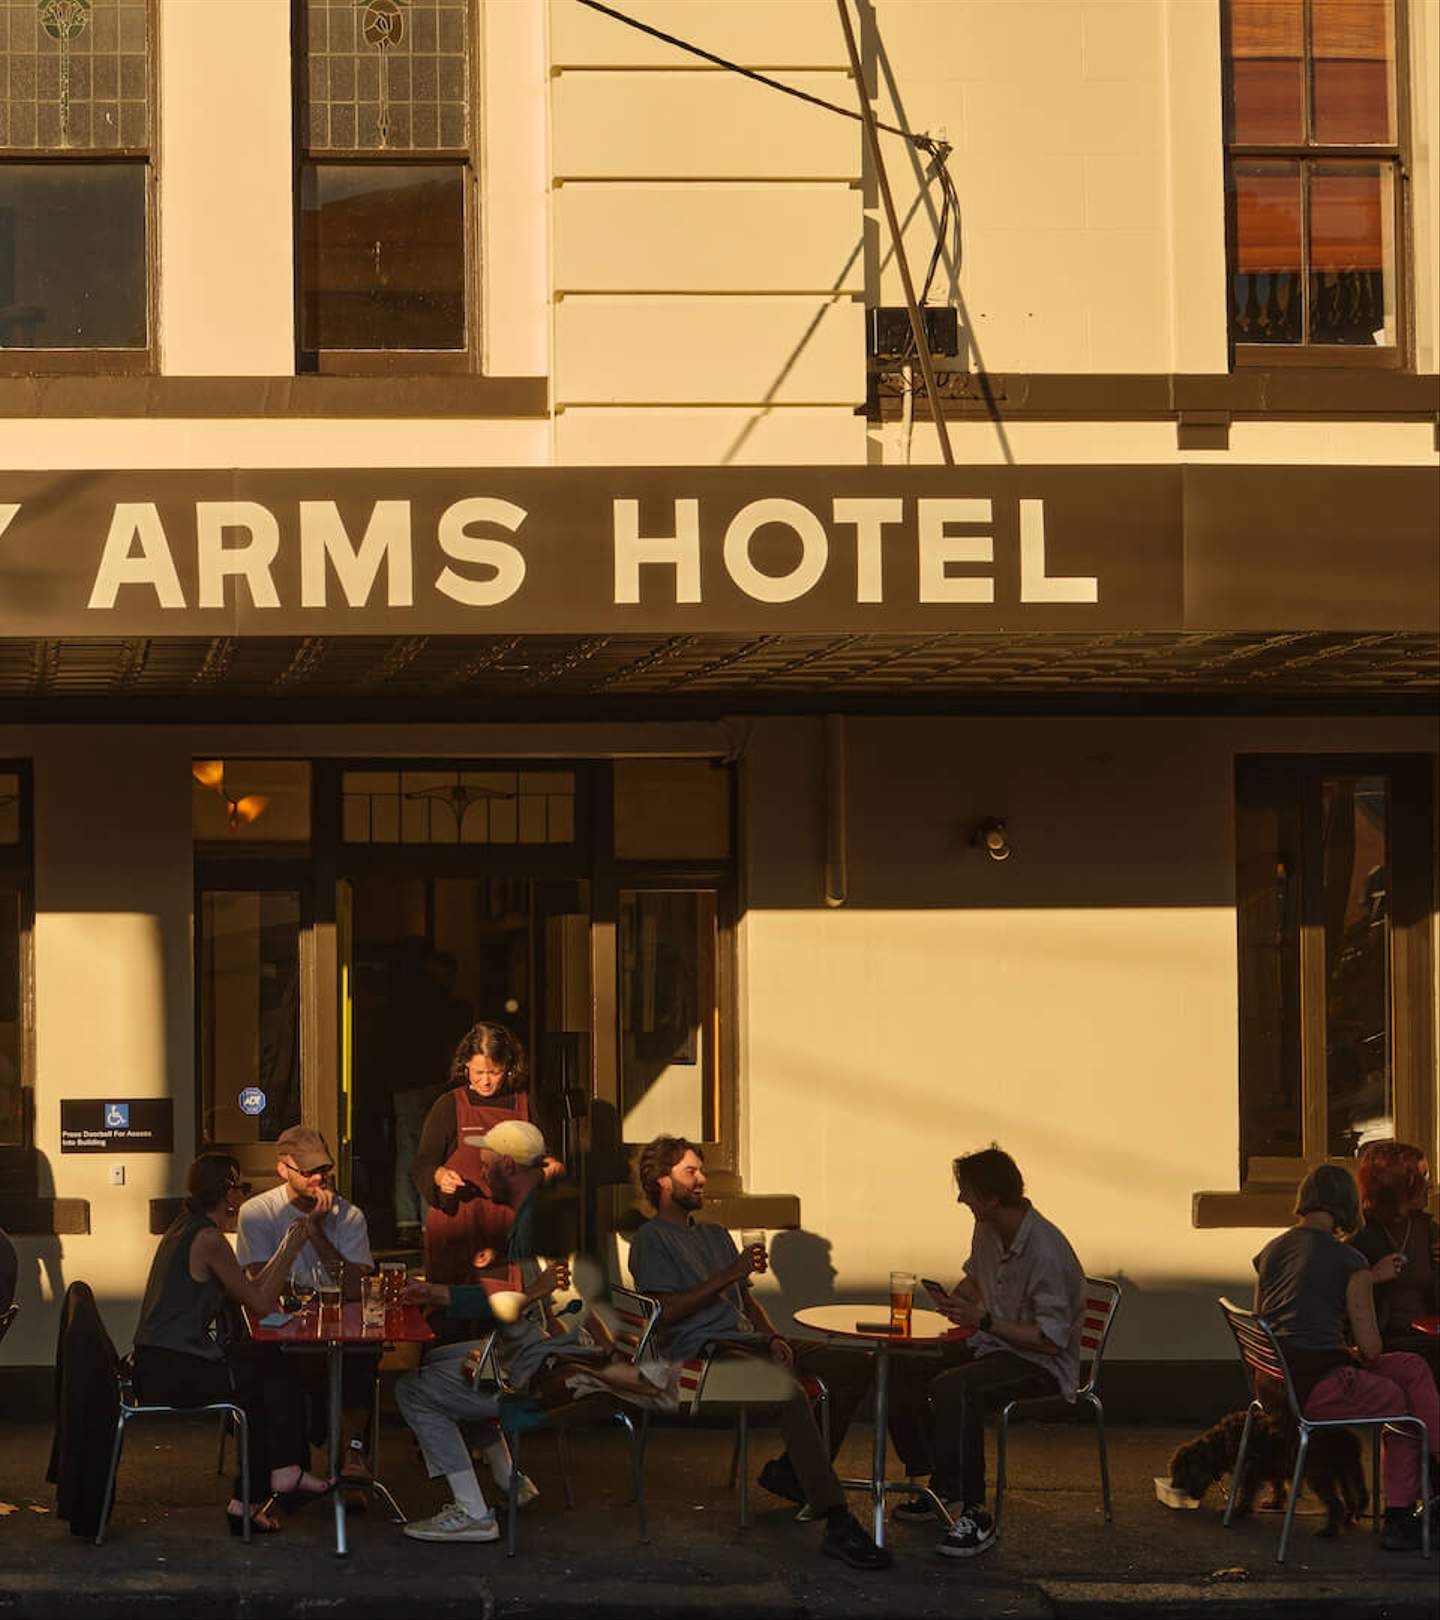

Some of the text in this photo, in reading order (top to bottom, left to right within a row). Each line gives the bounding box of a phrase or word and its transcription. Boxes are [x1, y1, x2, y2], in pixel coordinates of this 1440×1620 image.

[87, 497, 529, 609] ARMS
[613, 498, 1099, 604] HOTEL
[244, 1095, 261, 1105] ADT
[62, 1130, 81, 1138] Press
[83, 1130, 112, 1138] Doorbell
[113, 1130, 126, 1138] For
[77, 1139, 105, 1148] Building
